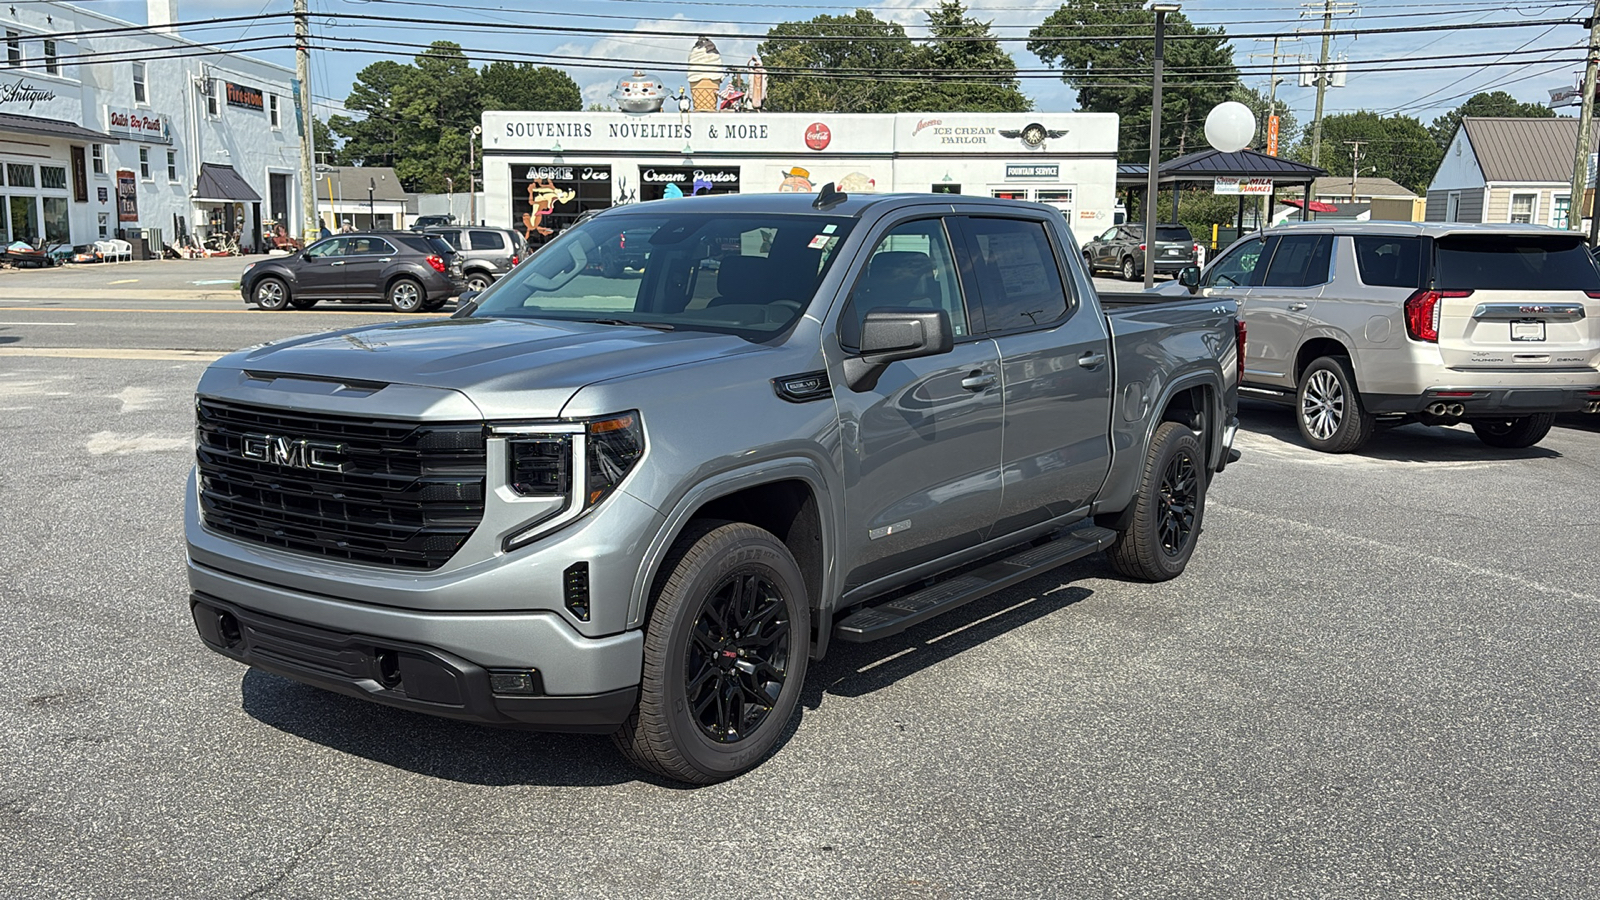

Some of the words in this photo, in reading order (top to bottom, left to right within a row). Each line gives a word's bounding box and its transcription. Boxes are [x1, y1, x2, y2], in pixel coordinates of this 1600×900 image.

[2, 78, 56, 110] Antiques
[226, 82, 263, 107] Firestone
[111, 112, 129, 127] Dutch
[130, 115, 142, 131] Boy
[143, 116, 160, 131] Paints
[506, 122, 592, 137] SOUVENIRS
[609, 123, 692, 139] NOVELTIES
[708, 125, 719, 139] &
[725, 125, 769, 139] MORE
[933, 127, 953, 135] ICE
[954, 127, 996, 135] CREAM
[941, 136, 987, 144] PARLOR
[526, 167, 574, 180] ACME
[581, 167, 610, 180] Ice
[643, 168, 687, 182] Cream
[693, 169, 738, 183] Parlor
[1007, 167, 1035, 176] FOUNTAIN
[1035, 167, 1058, 176] SERVICE
[240, 432, 344, 474] GMC
